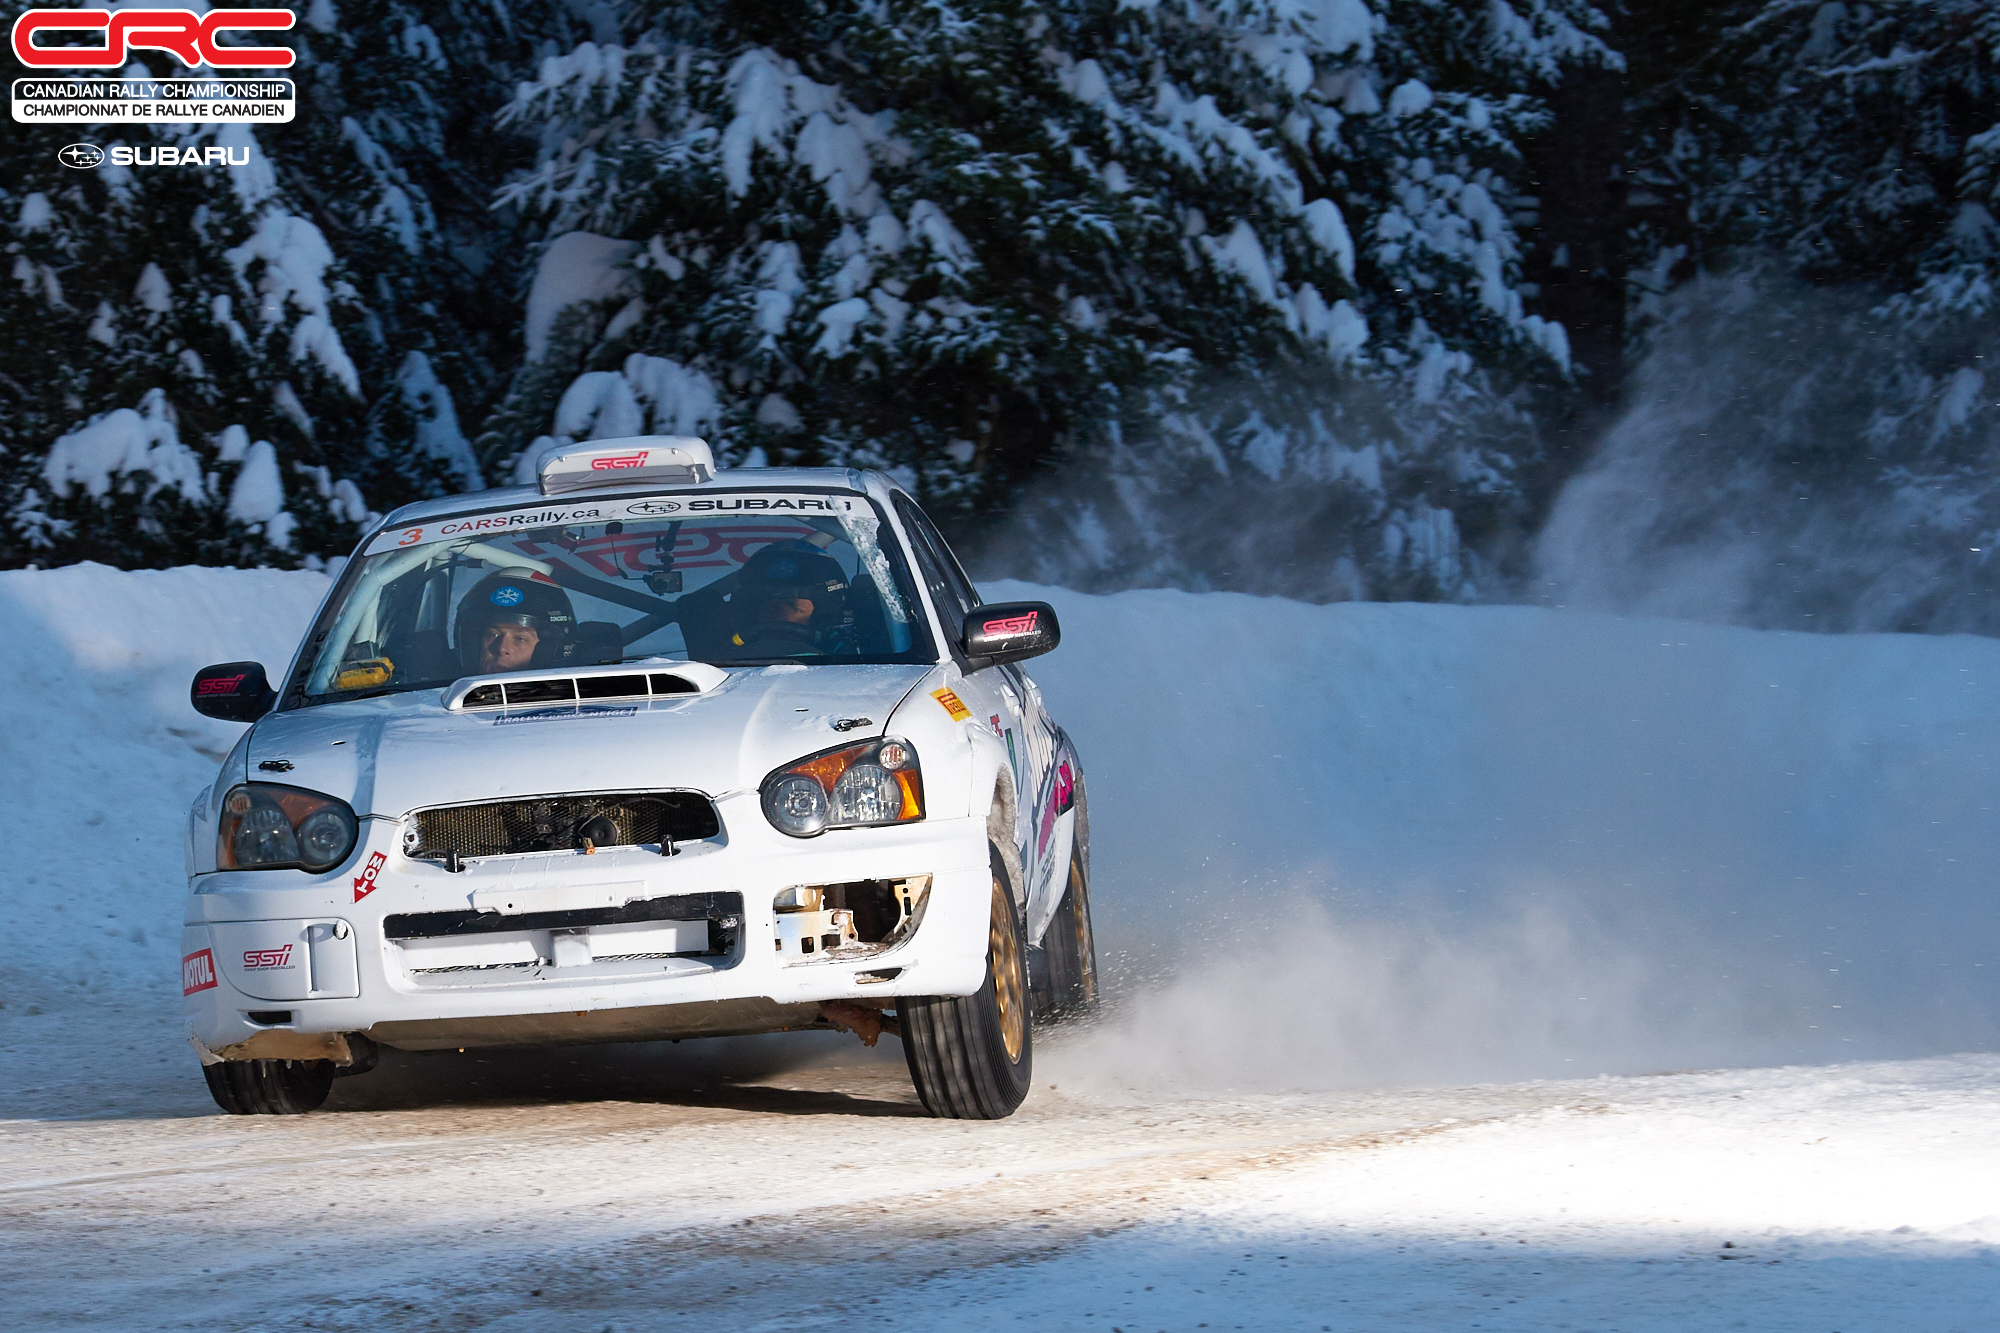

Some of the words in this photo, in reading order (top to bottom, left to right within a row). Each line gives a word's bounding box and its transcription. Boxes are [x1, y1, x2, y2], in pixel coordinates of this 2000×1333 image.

[398, 528, 423, 546] 3
[440, 508, 600, 535] CARSRally.ca
[937, 692, 966, 715] PIRELLI
[356, 855, 384, 894] TOW
[184, 955, 214, 990] MOTUL
